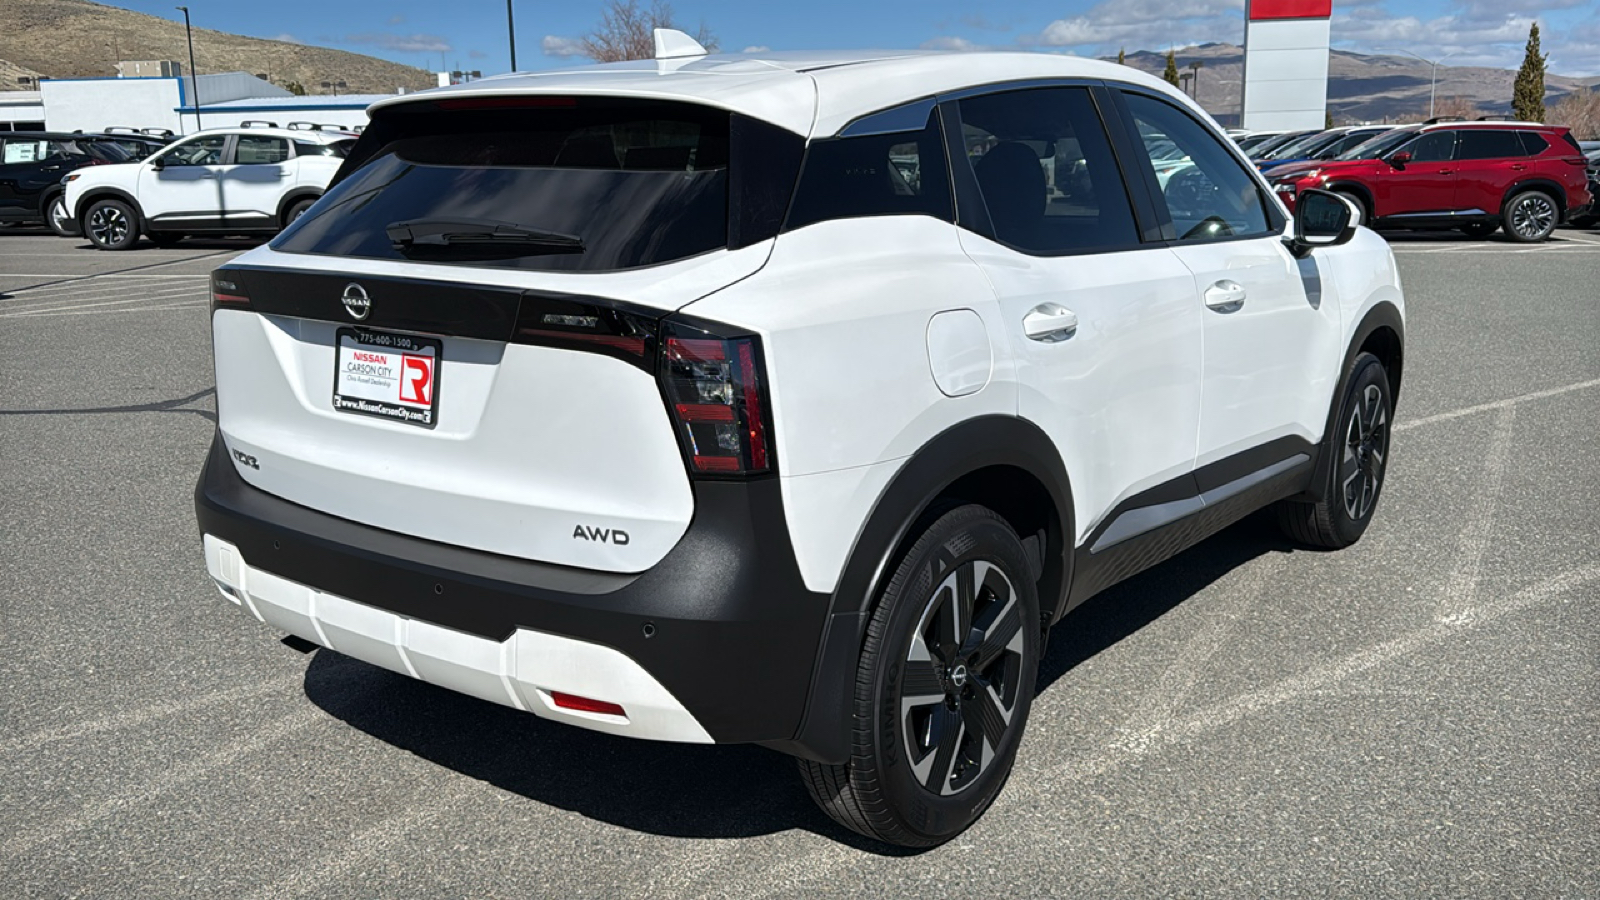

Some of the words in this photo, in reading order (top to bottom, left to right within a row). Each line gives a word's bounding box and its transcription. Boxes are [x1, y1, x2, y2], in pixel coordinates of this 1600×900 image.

[341, 297, 370, 306] NISSAN
[361, 333, 411, 347] 775-600-1500
[354, 352, 387, 364] NISSAN
[347, 362, 376, 375] CARSON
[377, 366, 392, 377] CITY
[342, 400, 425, 420] www.NissanCarsonCity.com
[573, 525, 629, 545] AWD
[883, 662, 898, 768] KUMHO
